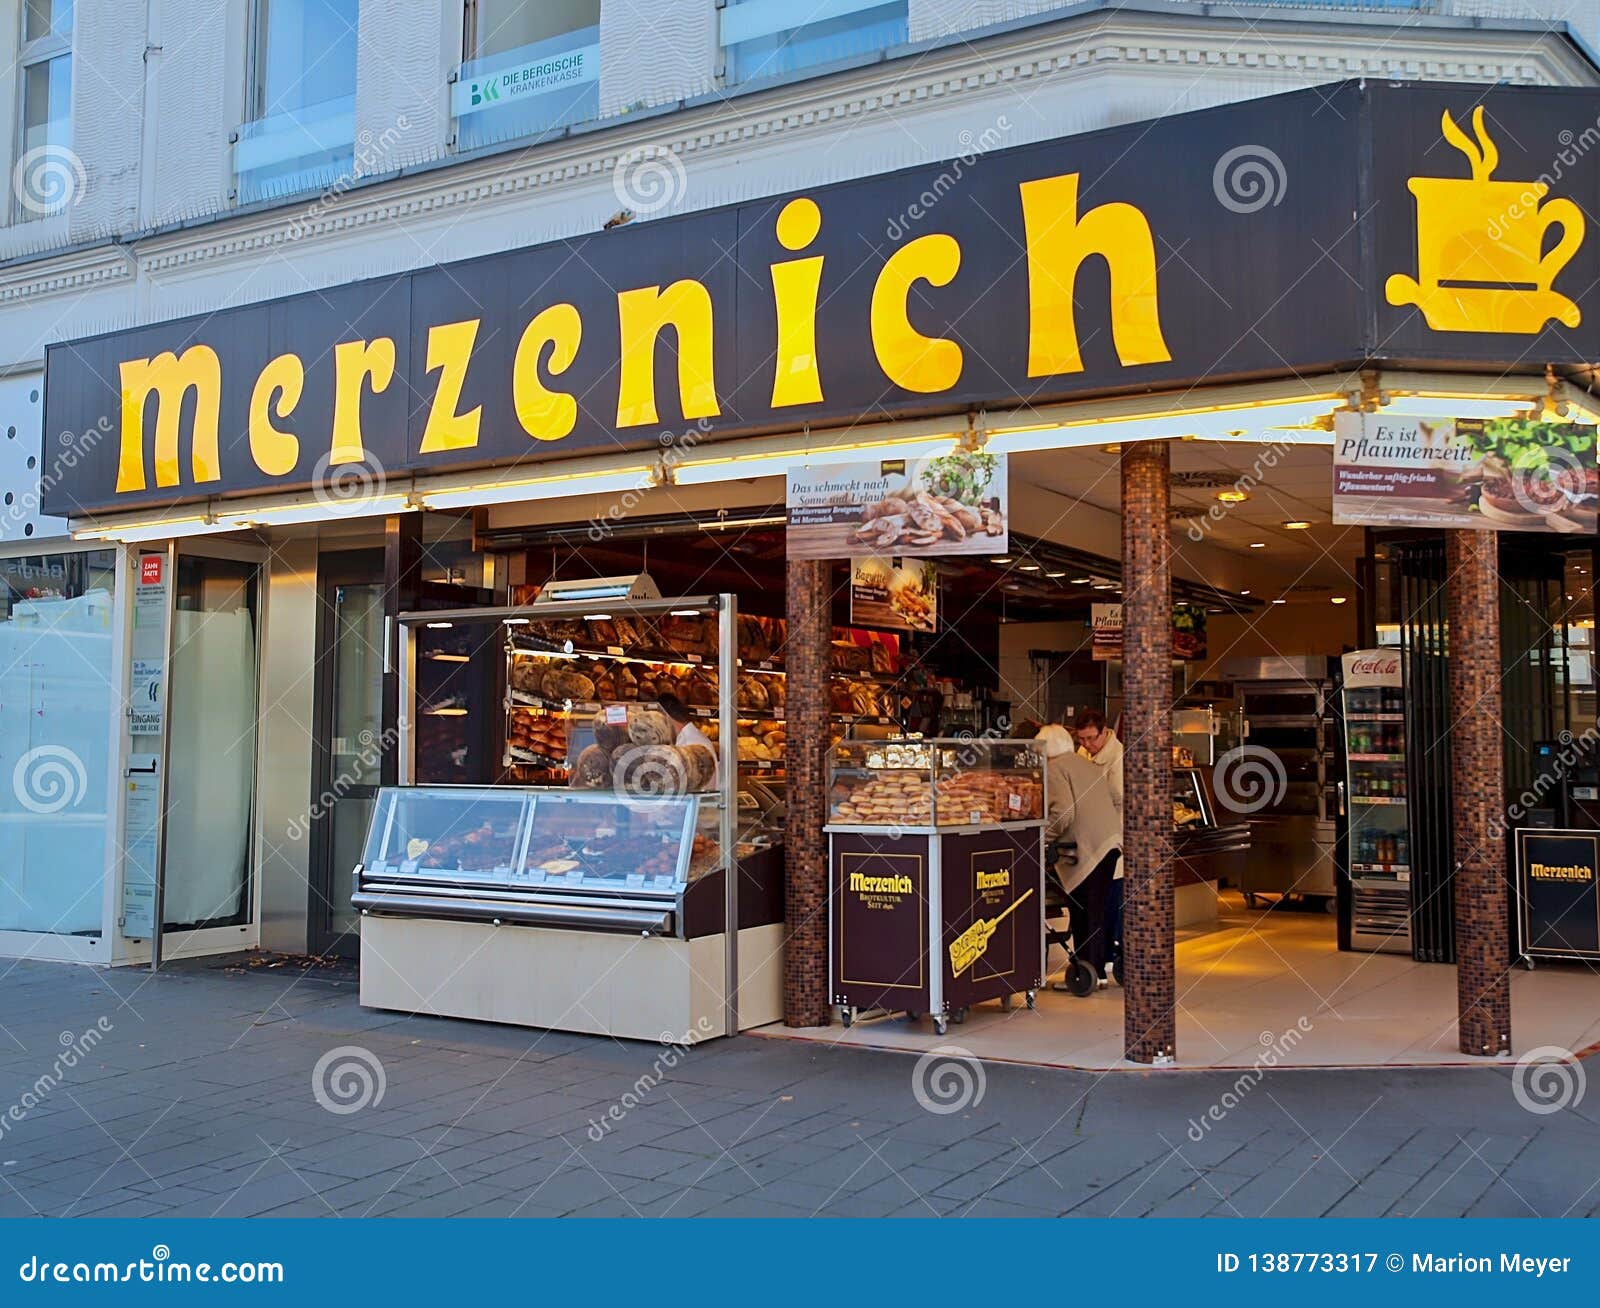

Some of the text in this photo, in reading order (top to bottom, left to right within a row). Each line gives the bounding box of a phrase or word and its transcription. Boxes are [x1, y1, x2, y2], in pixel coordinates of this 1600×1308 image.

[503, 54, 583, 87] DIE BERGISCHE
[510, 67, 583, 96] KRANKENKASSE
[1376, 426, 1417, 442] Es ist
[1340, 438, 1475, 463] Pflaumenzeit!
[791, 477, 889, 494] Das schmeckt nach
[799, 492, 887, 505] Sonne und Urlaub
[131, 714, 160, 724] EINGANG
